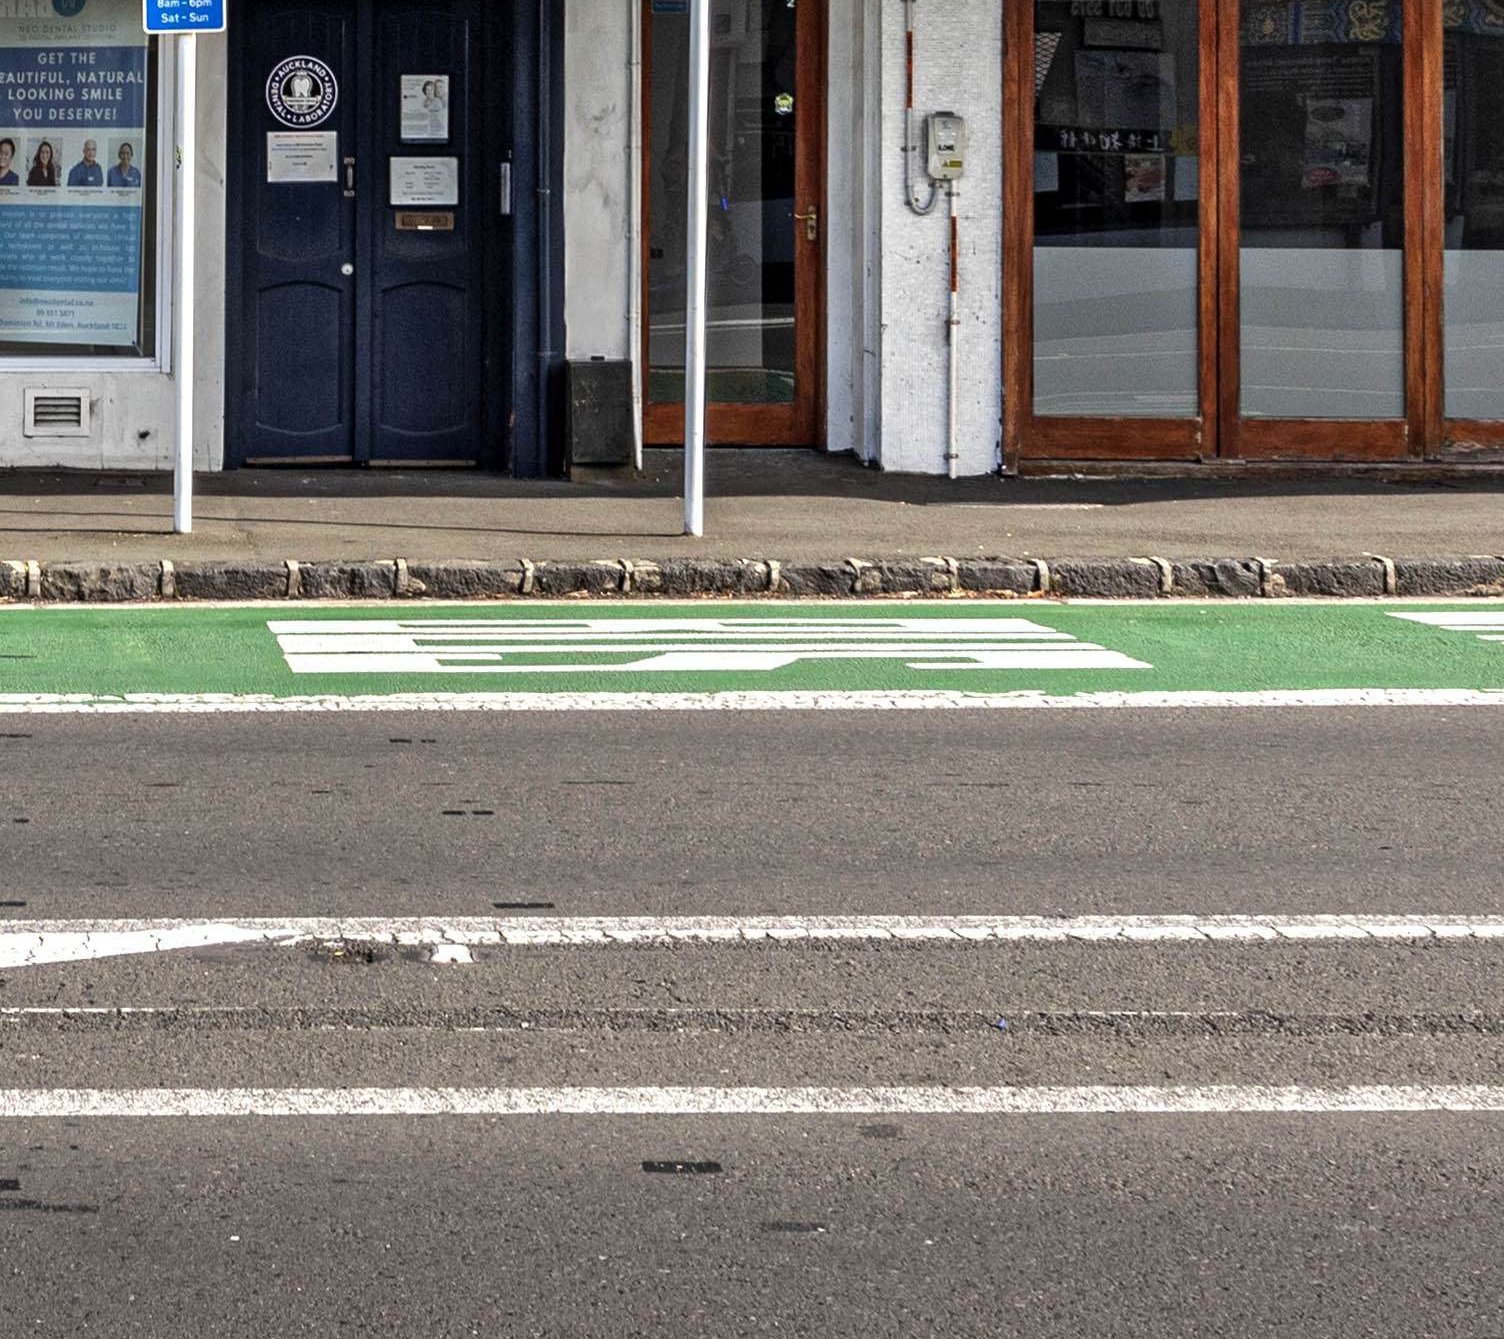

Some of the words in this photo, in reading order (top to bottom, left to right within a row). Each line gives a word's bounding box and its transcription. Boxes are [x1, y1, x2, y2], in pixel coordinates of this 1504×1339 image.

[161, 13, 179, 23] Sat
[189, 12, 209, 23] Sun
[38, 52, 63, 65] GET
[72, 52, 96, 64] THE
[278, 61, 326, 78] AUCKLAND
[77, 71, 144, 84] NATURAL
[8, 88, 75, 100] LOOKING
[81, 88, 123, 100] SMILE
[13, 108, 43, 121] YOU
[48, 108, 117, 120] DESERVE!
[265, 618, 1153, 674] BUS
